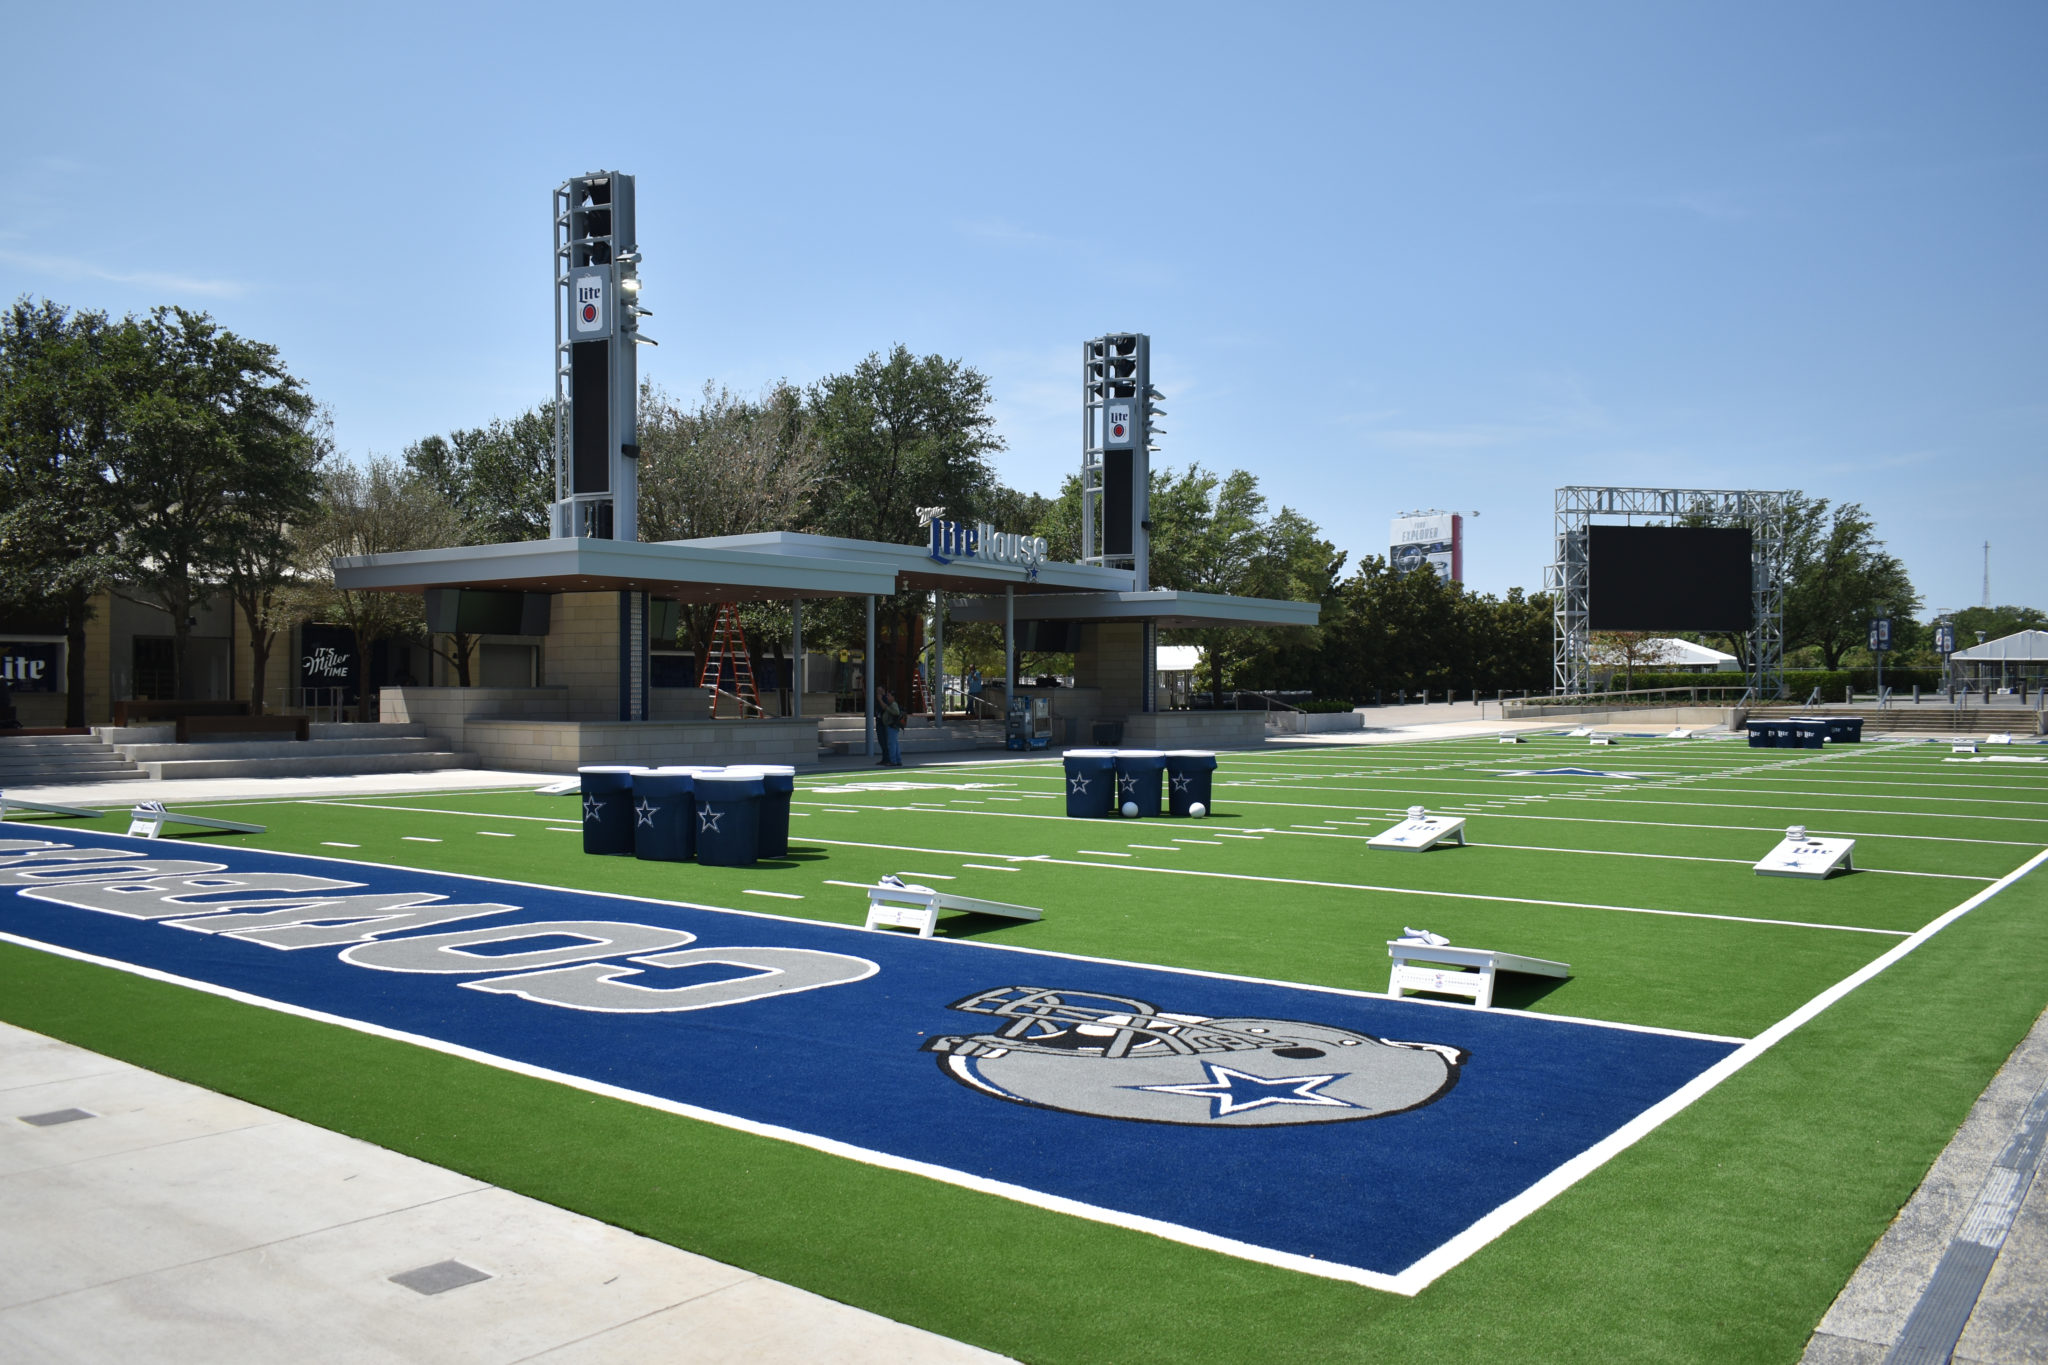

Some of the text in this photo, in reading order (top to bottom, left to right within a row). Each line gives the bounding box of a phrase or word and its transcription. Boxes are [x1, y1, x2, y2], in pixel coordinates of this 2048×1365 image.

[579, 287, 601, 303] Lite
[1111, 412, 1128, 424] Lite
[314, 647, 335, 657] IT'S
[0, 656, 46, 687] ite
[303, 654, 350, 676] Miller
[323, 667, 349, 677] TIME
[0, 838, 882, 1013] COWBO
